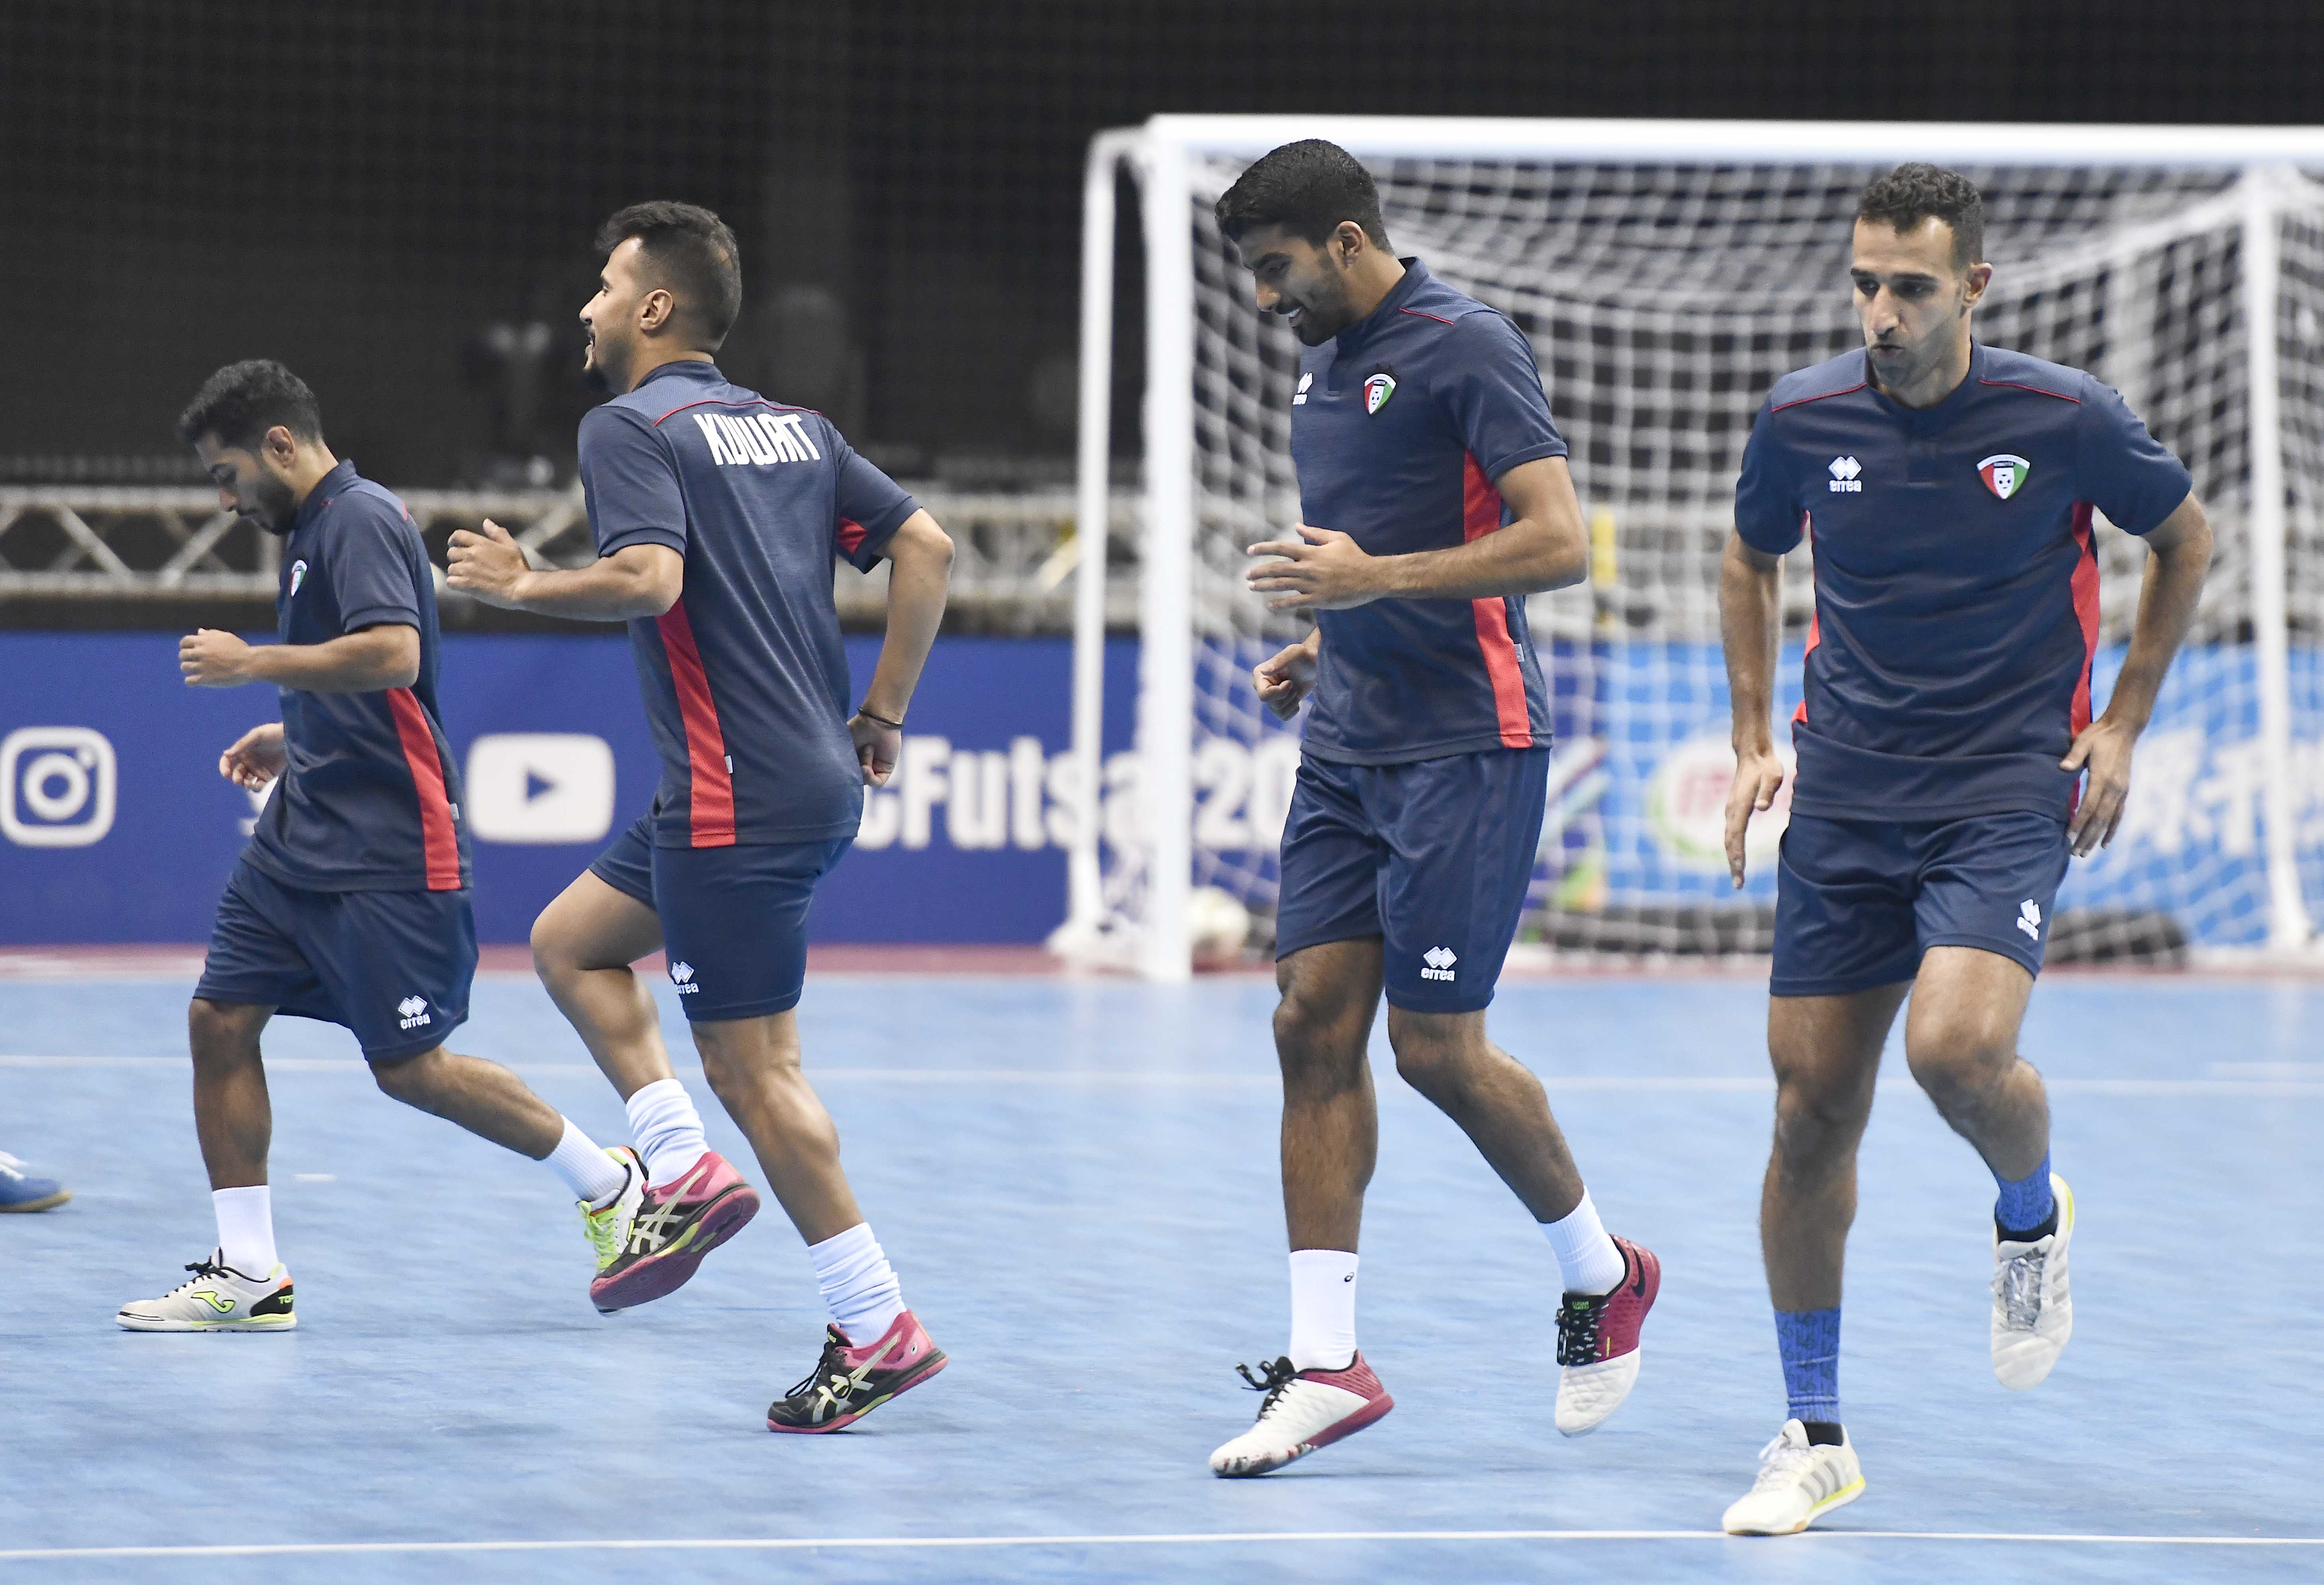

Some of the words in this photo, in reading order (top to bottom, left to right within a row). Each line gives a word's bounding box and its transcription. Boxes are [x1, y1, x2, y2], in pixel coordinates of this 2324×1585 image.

[693, 413, 821, 465] KUWAIT
[1421, 968, 1455, 981] errea
[400, 1013, 431, 1029] errea
